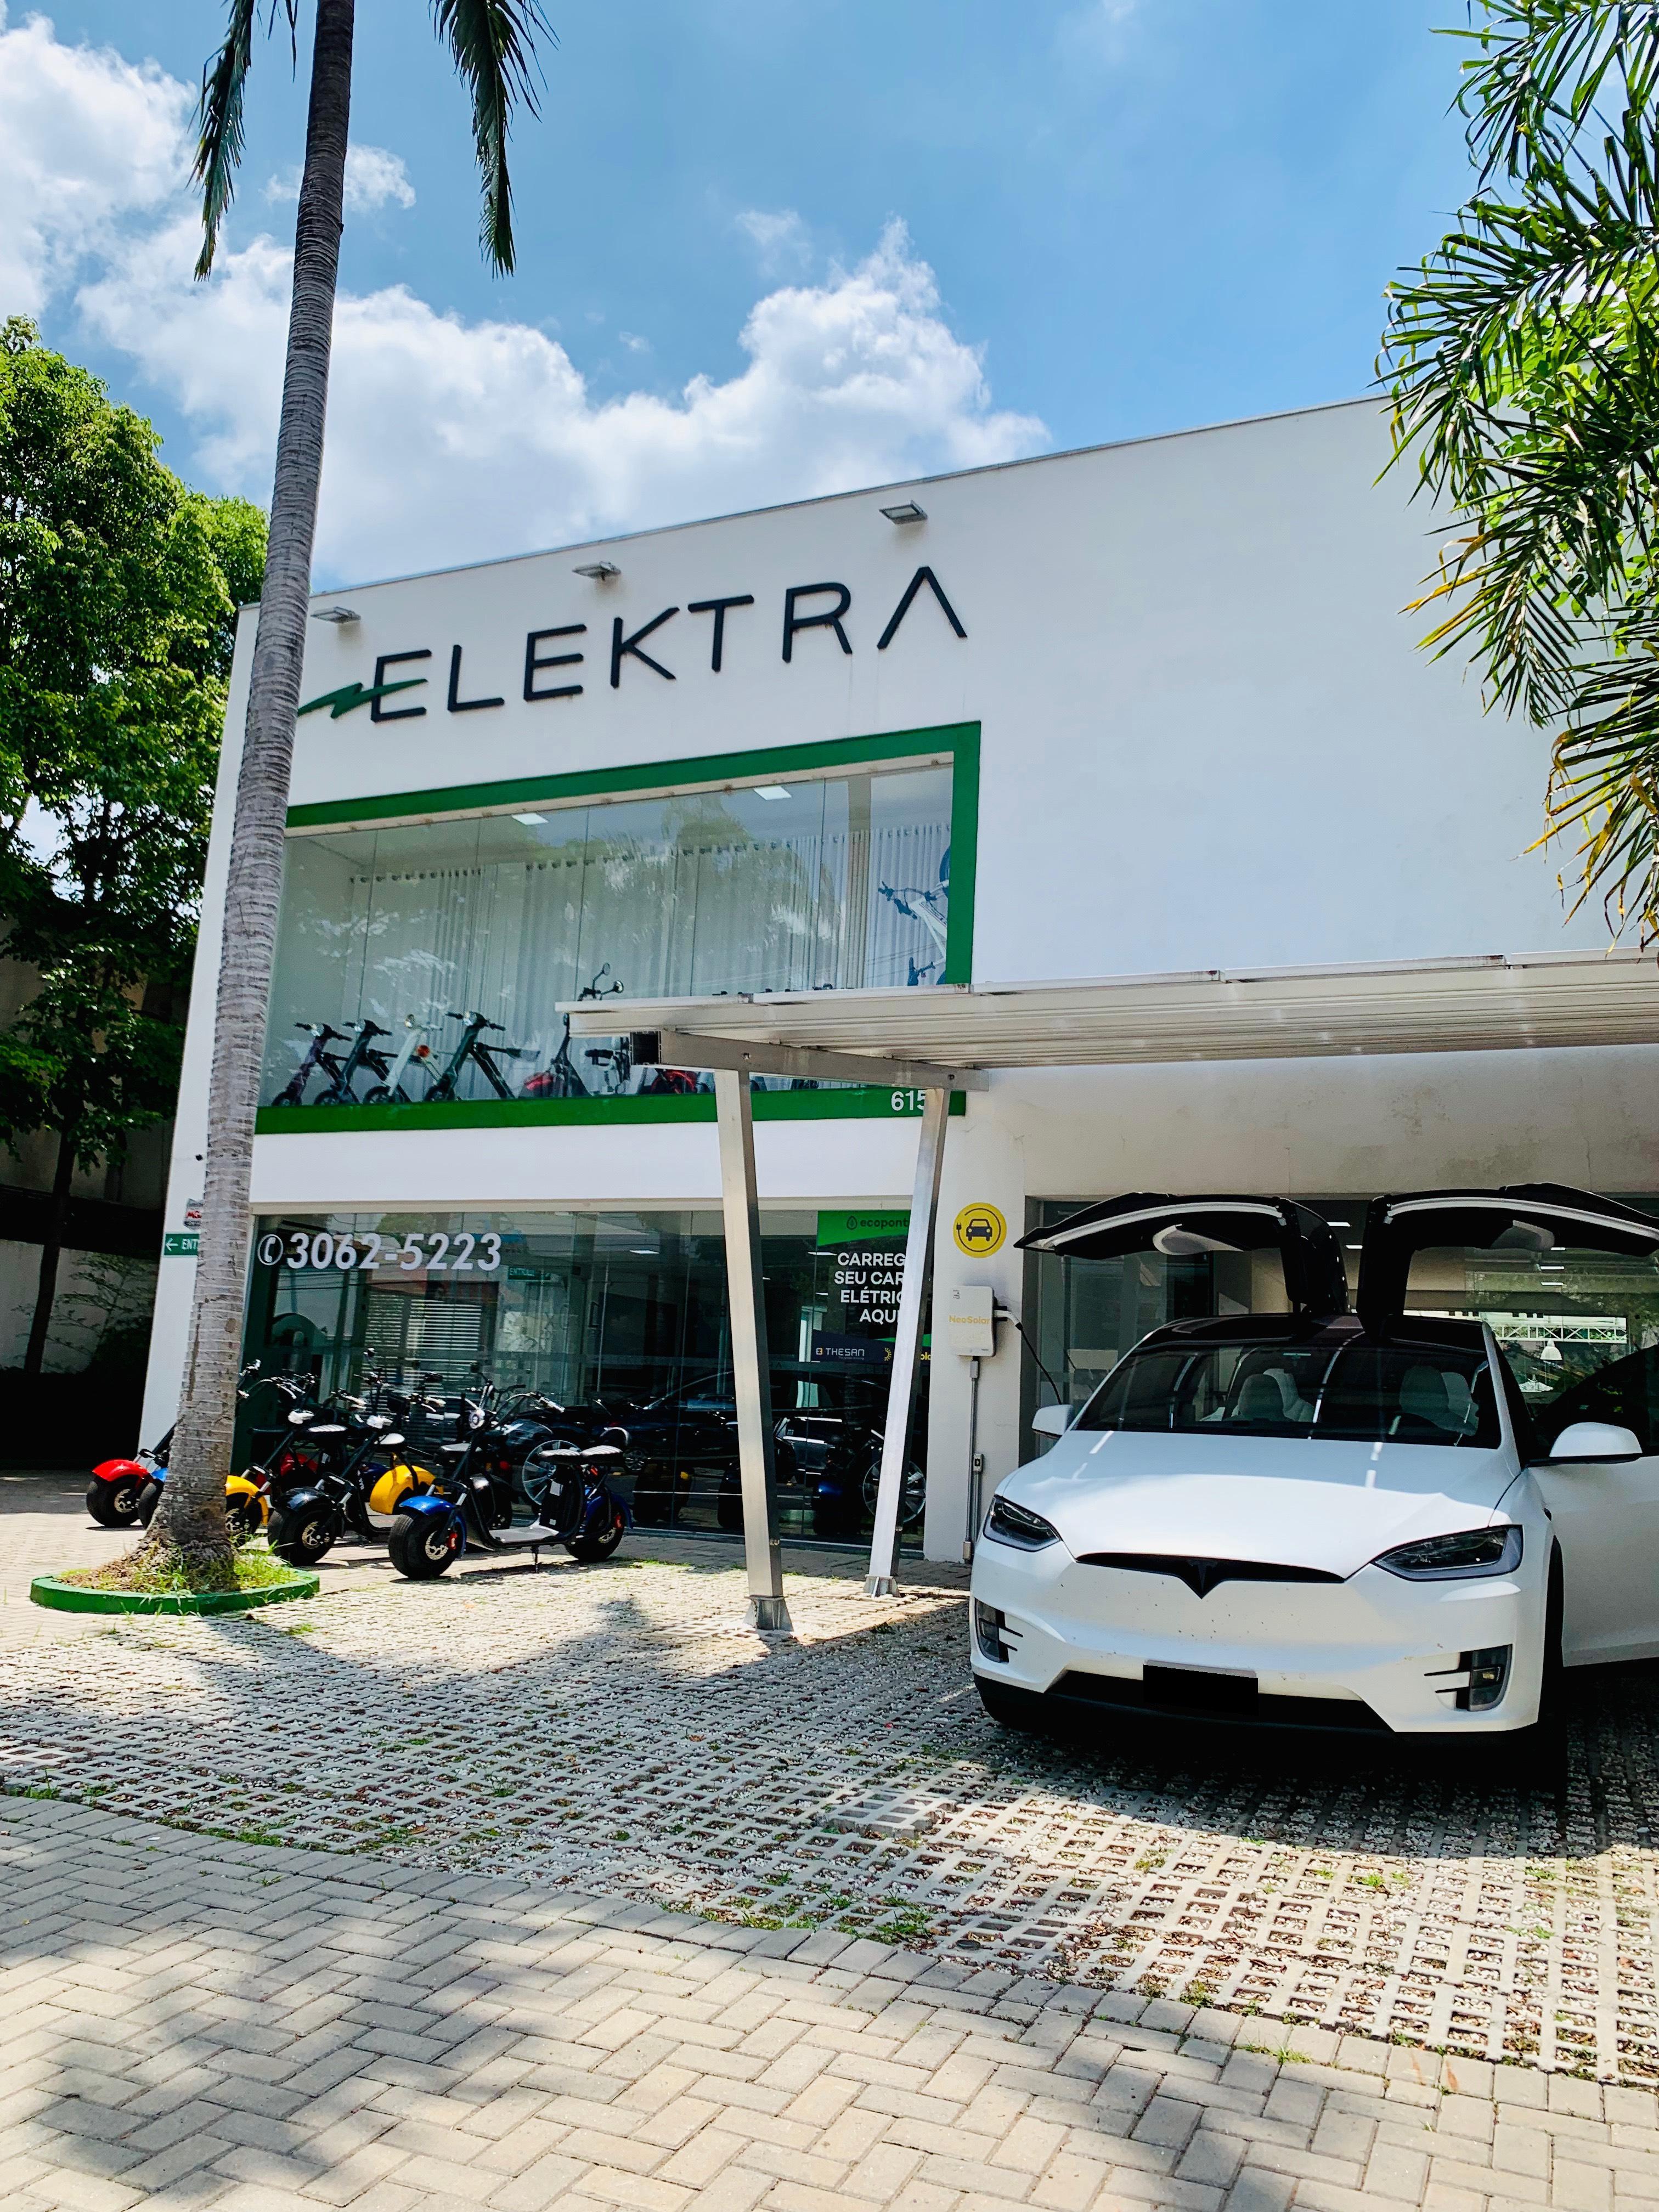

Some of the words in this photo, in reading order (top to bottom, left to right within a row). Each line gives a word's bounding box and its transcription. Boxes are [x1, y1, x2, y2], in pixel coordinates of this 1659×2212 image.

[370, 566, 968, 723] ELEKTRA
[891, 1090, 926, 1111] 615
[287, 1232, 501, 1271] 3062-5223
[837, 1252, 905, 1267] CARREG
[834, 1271, 866, 1284] SEU
[870, 1272, 904, 1285] CAR
[949, 1315, 990, 1324] NeoSolar
[826, 1347, 865, 1357] THESAN
